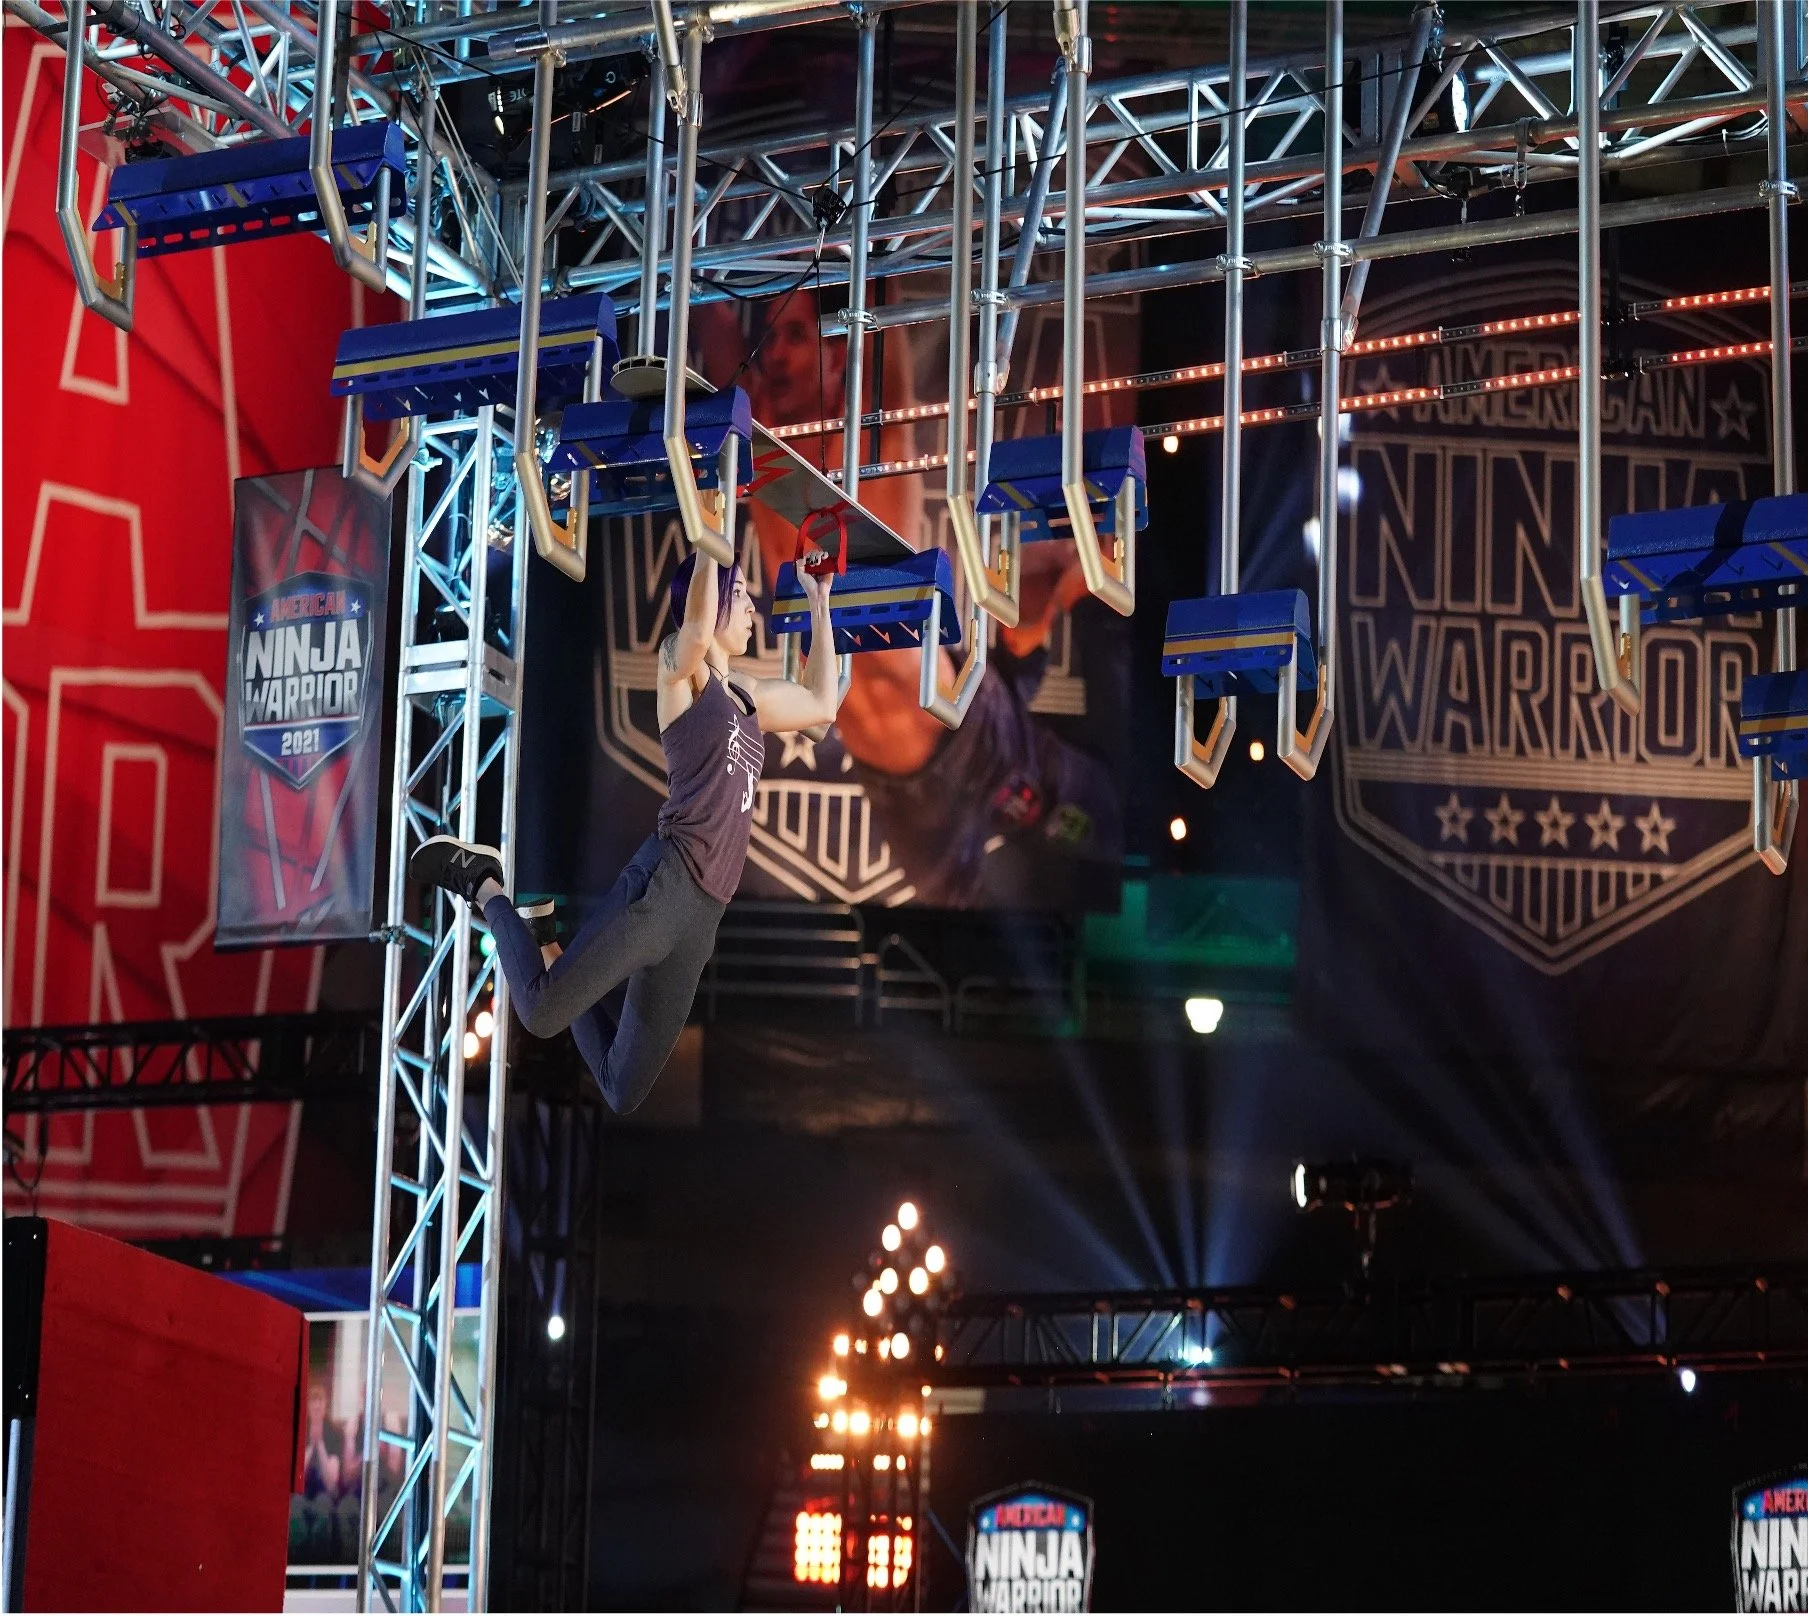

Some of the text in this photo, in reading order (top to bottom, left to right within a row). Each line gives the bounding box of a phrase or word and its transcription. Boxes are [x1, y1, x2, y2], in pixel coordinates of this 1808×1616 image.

[271, 591, 346, 624] AMERICAN
[246, 619, 361, 680] NINJA
[245, 671, 358, 724] WARRIOR
[281, 728, 320, 756] 2021
[975, 1530, 1084, 1580] NINJA
[1741, 1518, 1808, 1570] NIN
[976, 1579, 1082, 1613] WARRIOR
